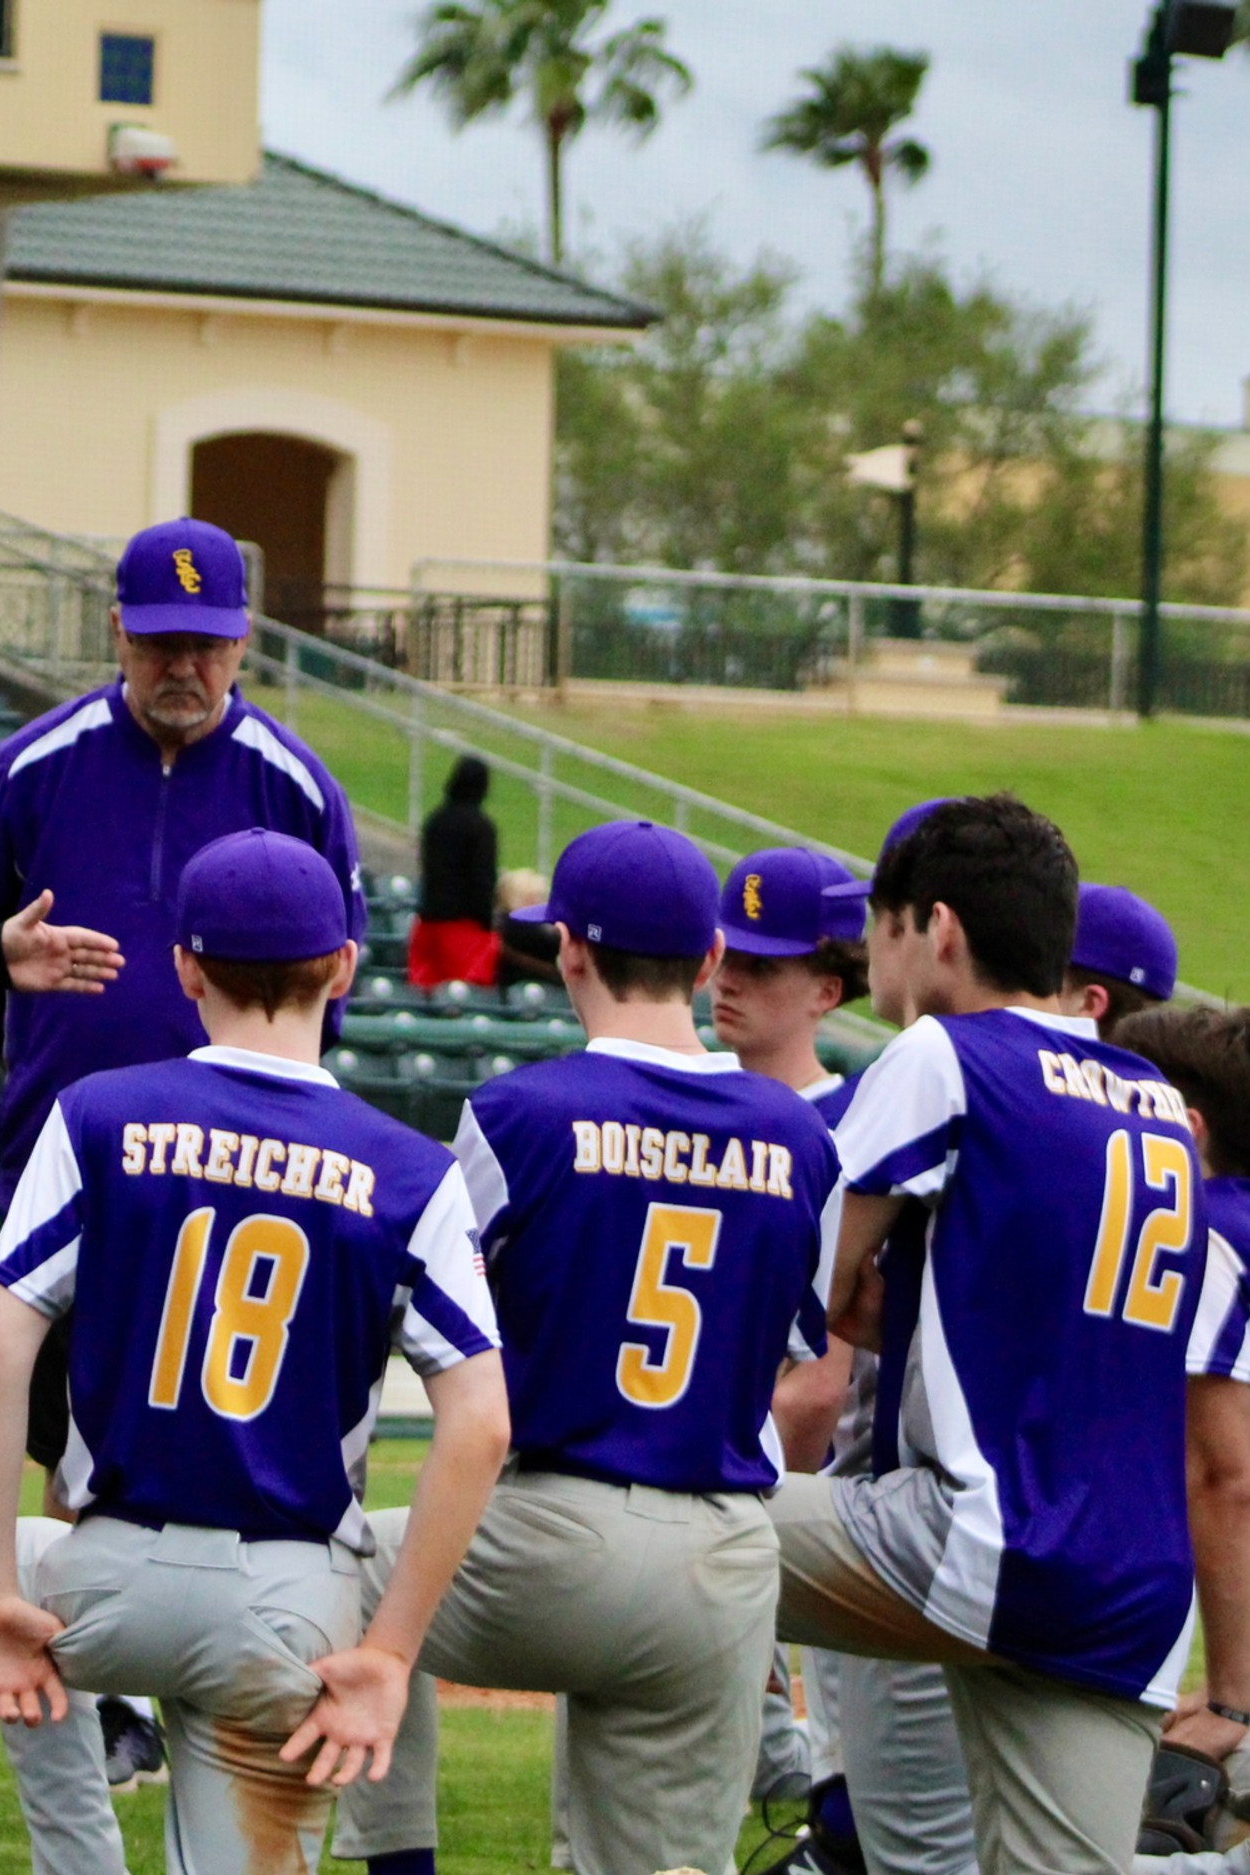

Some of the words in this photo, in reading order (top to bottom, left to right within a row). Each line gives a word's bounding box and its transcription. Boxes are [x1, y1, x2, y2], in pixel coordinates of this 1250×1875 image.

[122, 1123, 375, 1218] STREICHER
[572, 1120, 793, 1199] BOISCLAIR
[1083, 1128, 1193, 1333] 12
[148, 1206, 310, 1422] 18
[615, 1201, 722, 1409] 5
